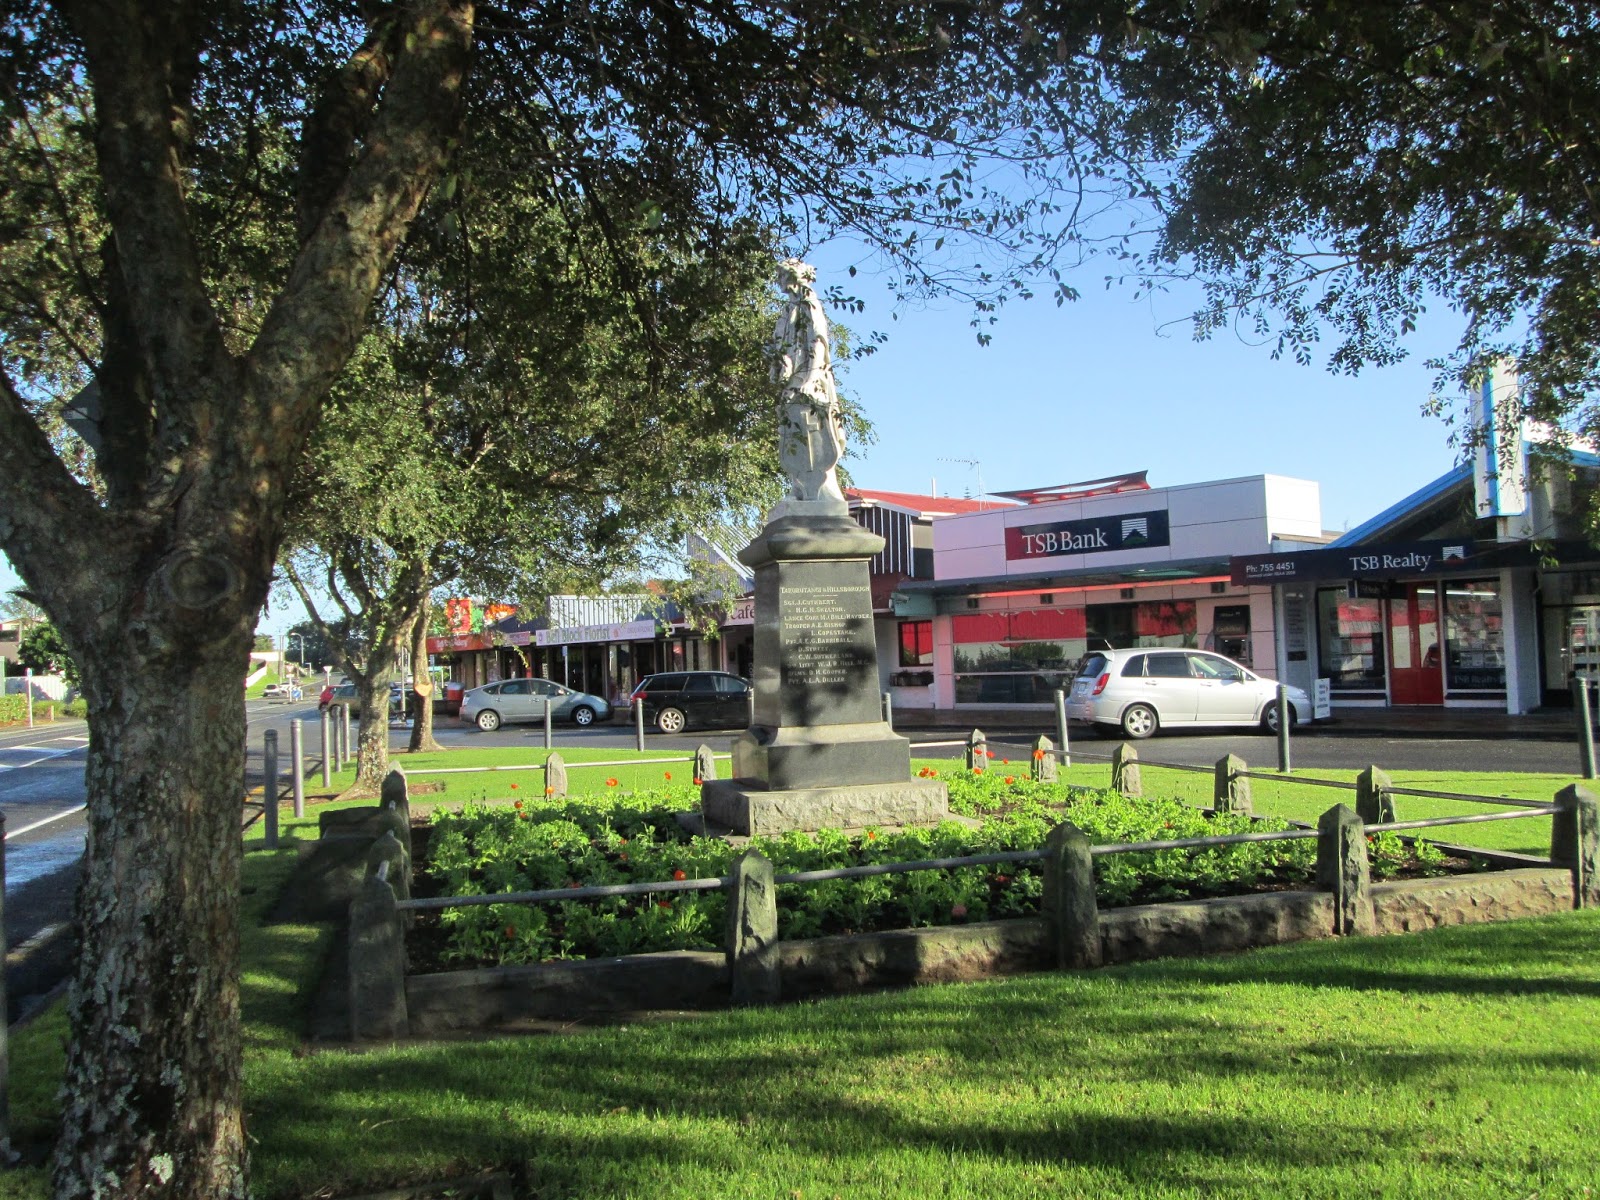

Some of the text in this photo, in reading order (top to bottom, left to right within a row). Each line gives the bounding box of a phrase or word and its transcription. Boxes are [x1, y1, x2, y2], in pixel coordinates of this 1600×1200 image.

[1022, 528, 1108, 554] TSB Bank
[1246, 562, 1295, 573] Ph: 755 4451
[1349, 553, 1431, 571] TSB Realty
[561, 627, 584, 642] Block
[584, 625, 610, 641] Florist
